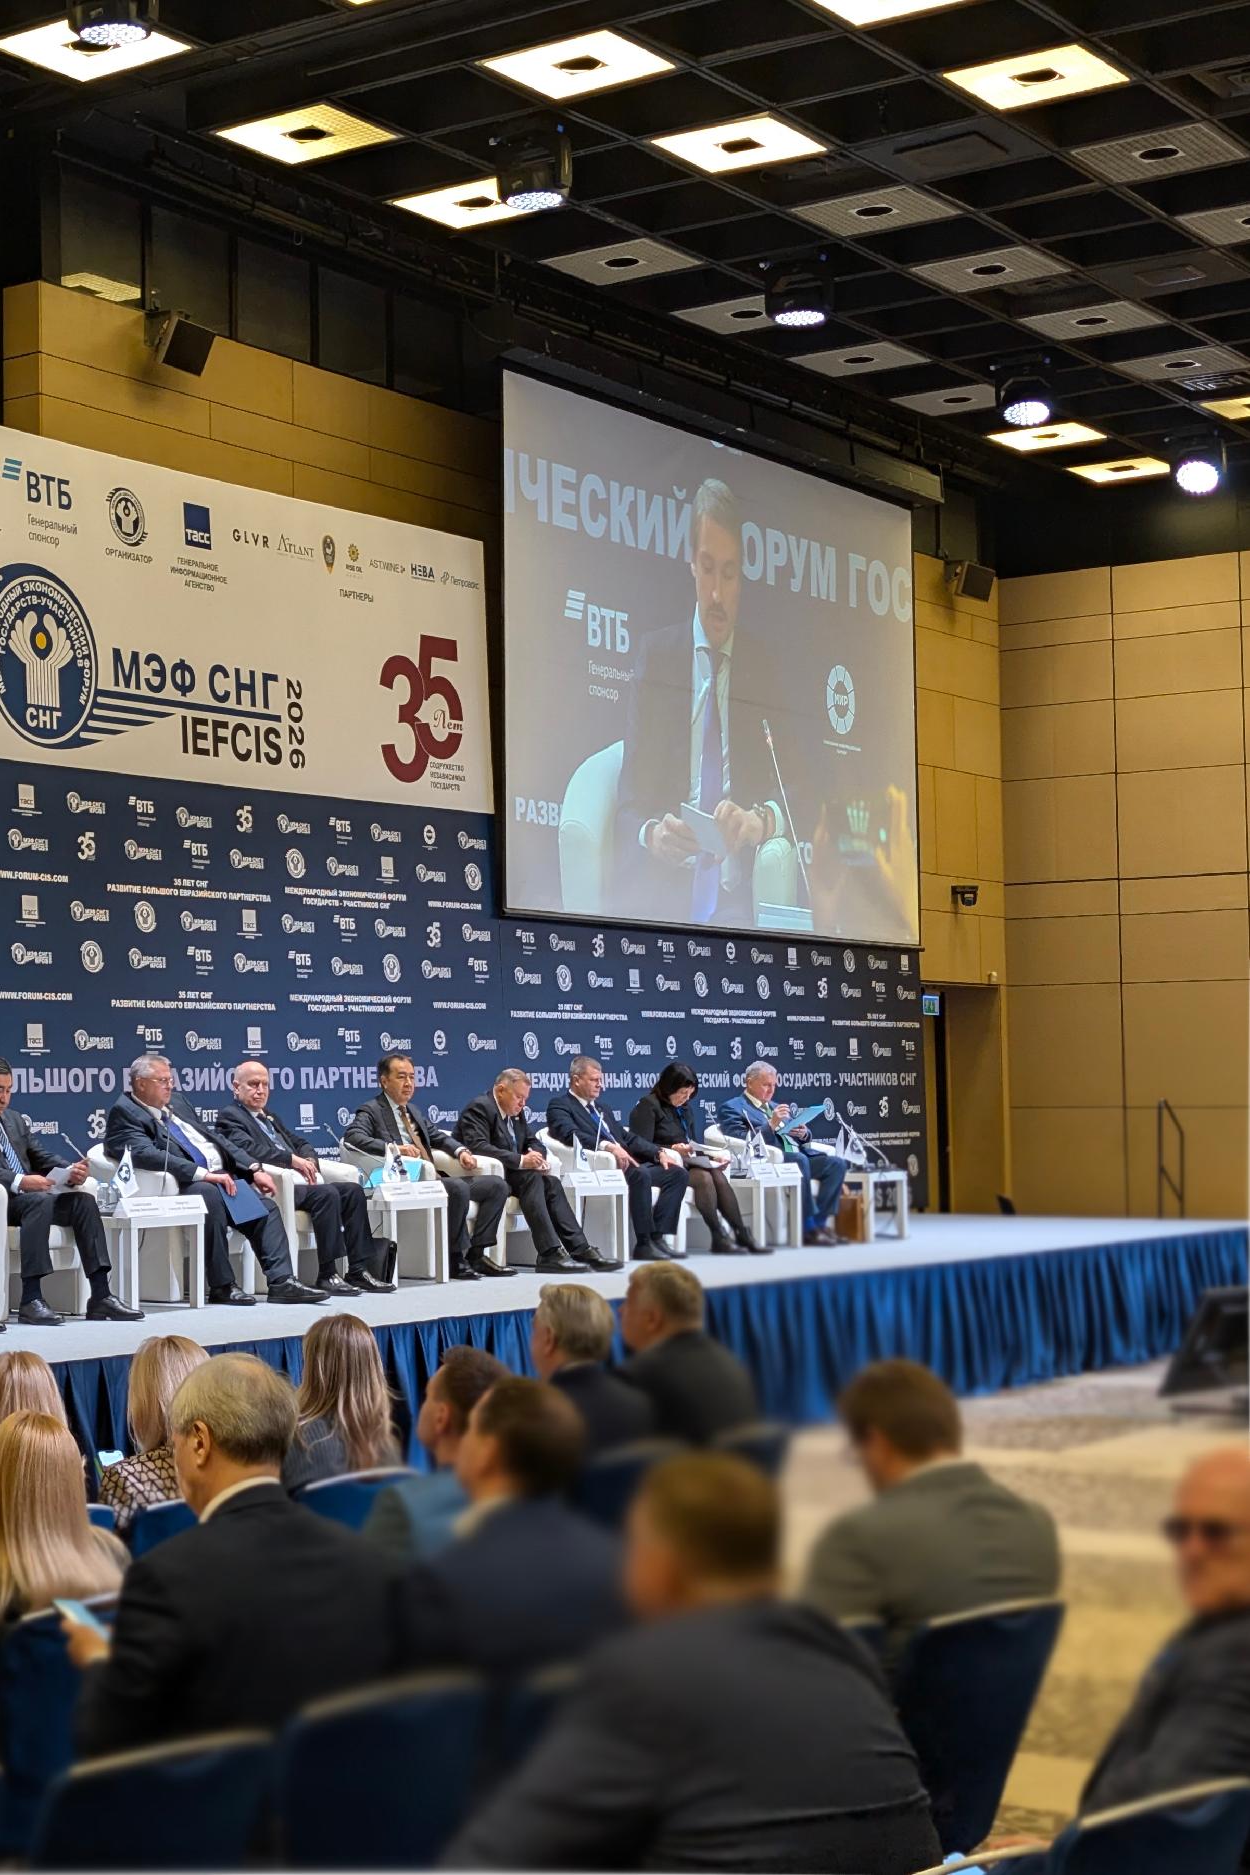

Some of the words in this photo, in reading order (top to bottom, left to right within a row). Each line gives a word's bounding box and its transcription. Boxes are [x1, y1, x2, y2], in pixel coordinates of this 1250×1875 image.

[26, 470, 73, 511] ВТБ
[27, 513, 78, 535] Генеральный
[28, 531, 60, 549] спонсор
[232, 528, 269, 549] GLVR
[105, 547, 153, 564] ОРГАНИЗАТОР
[177, 557, 219, 572] ГЕНЕРАЛЬНОЕ
[170, 566, 228, 584] ИНФОРМАЦИОННОЕ
[339, 588, 374, 603] ПАРТНЕРЫ
[586, 603, 630, 654] ВТБ
[23, 582, 89, 656] ЭКОНОМИЧЕСКИЙ
[79, 658, 91, 705] ФОРУМ
[112, 648, 196, 698] МЭФ
[208, 664, 279, 710] СНГ
[588, 683, 619, 703] спонсор
[26, 706, 62, 730] СНГ
[379, 634, 464, 783] 35
[286, 677, 306, 769] 2026
[181, 715, 282, 766] IEFCIS
[515, 796, 560, 827] РАЗВ
[107, 884, 141, 893] РАЗВИТИЕ
[11, 1067, 117, 1094] ЛЬШОГО
[839, 1072, 899, 1088] УЧАСТНИКОВ
[899, 1072, 917, 1086] СНГ
